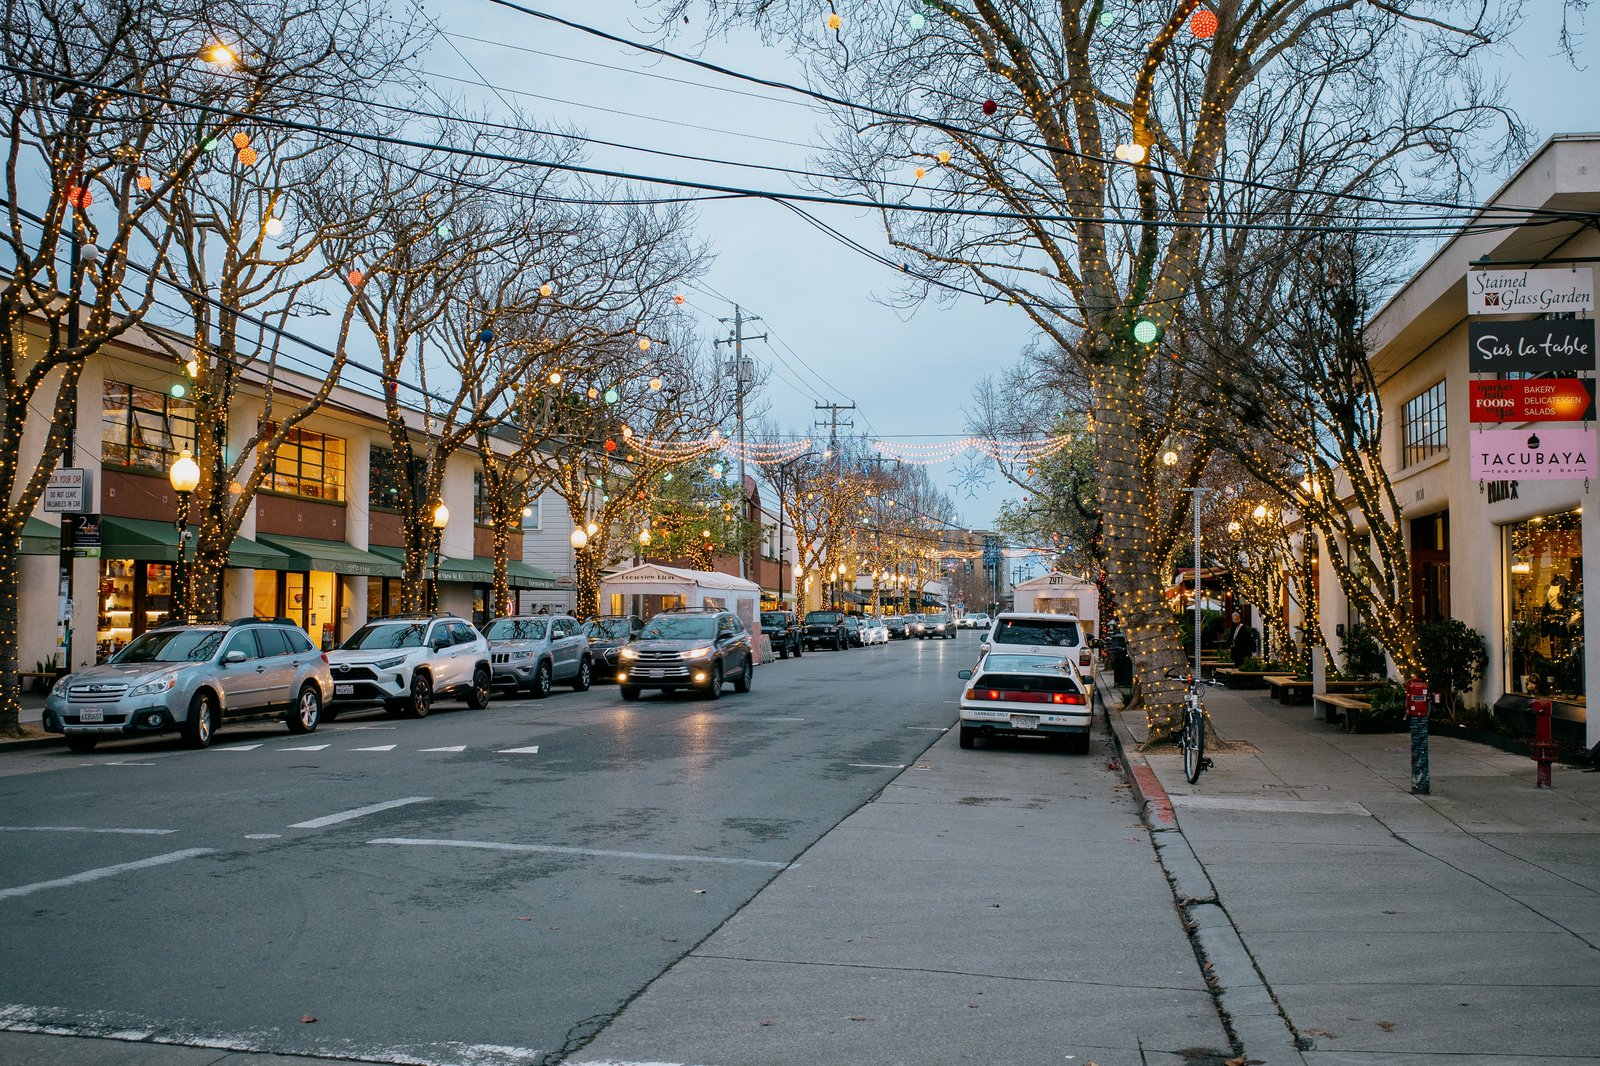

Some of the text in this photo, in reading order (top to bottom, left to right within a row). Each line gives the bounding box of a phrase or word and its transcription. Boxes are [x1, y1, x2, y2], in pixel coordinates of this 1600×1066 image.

[1473, 272, 1528, 295] Stained
[1501, 287, 1590, 311] Glass Garden
[1476, 333, 1588, 360] Sur la table
[1524, 386, 1556, 394] BAKERY
[1476, 399, 1515, 408] FOODS
[1524, 396, 1582, 405] DELICATESSEN
[1524, 408, 1556, 416] SALADS
[1481, 452, 1587, 466] TACUBAYA
[47, 475, 81, 484] OCK YOUR CAR
[1049, 576, 1063, 585] ZUT!
